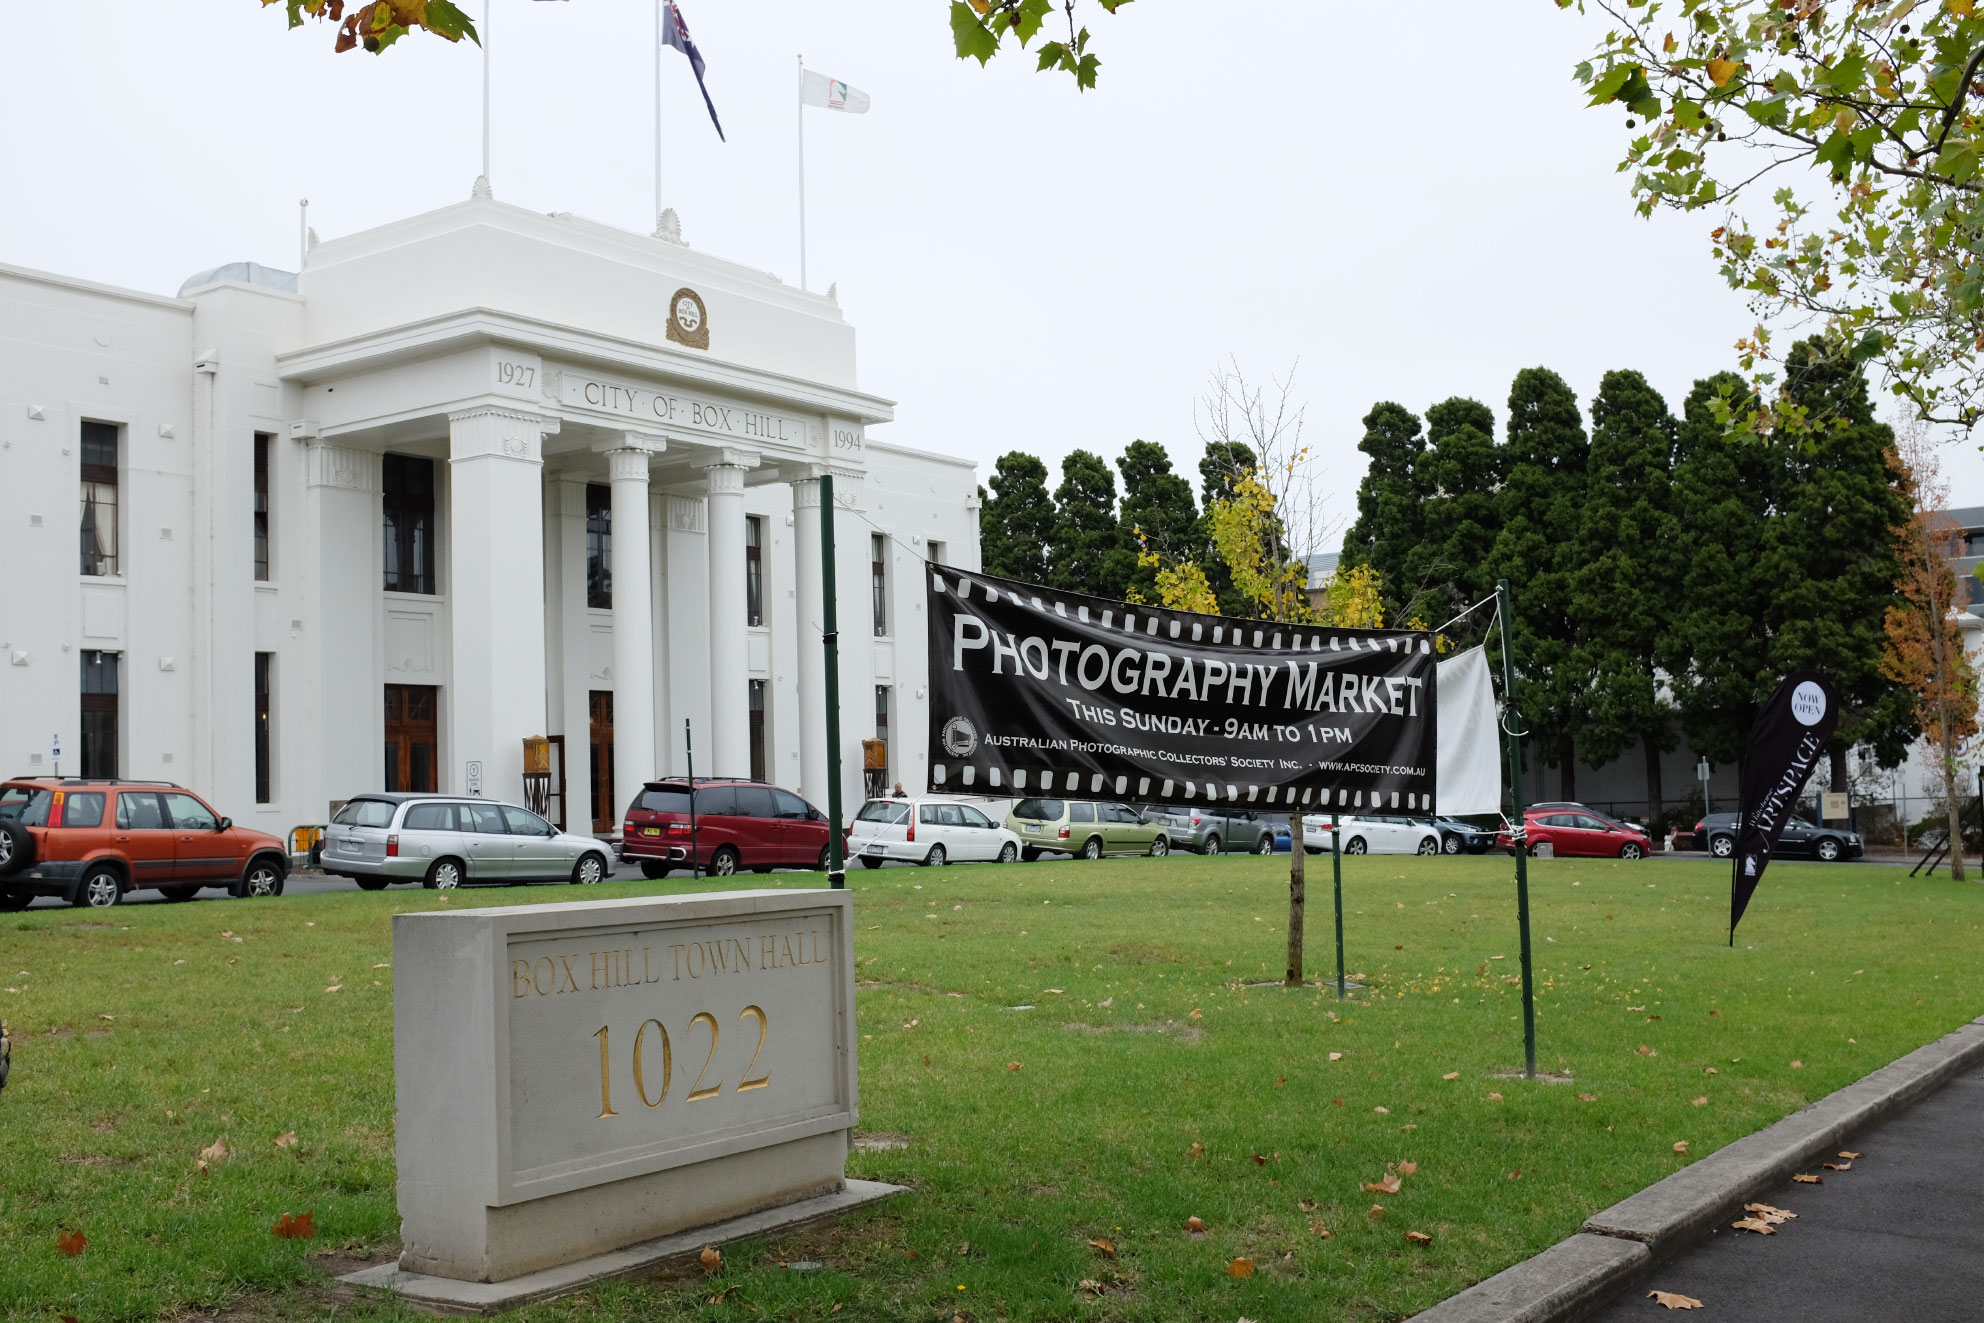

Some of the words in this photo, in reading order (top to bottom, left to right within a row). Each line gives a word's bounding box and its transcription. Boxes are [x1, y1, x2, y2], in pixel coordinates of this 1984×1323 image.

[496, 361, 535, 388] 1927
[584, 382, 638, 412] CITY
[653, 396, 677, 419] OF
[692, 402, 732, 431] BOX
[745, 412, 788, 441] HILL
[833, 430, 862, 451] 1994
[953, 613, 1279, 707] PHOTOGRAPHY
[1283, 660, 1423, 717] MARKET
[1066, 698, 1117, 726] THIS
[1119, 707, 1211, 737] SUNDAY
[1223, 718, 1269, 741] 9AM
[1273, 725, 1300, 743] TO
[1307, 724, 1353, 743] 1PM
[1794, 703, 1821, 714] OPEN
[1798, 692, 1819, 704] NOW
[984, 733, 1067, 750] AUSTRALIAN
[1070, 739, 1156, 760] PHOTOGRAPHIC
[1158, 750, 1228, 767] COLLECTORS'
[1230, 756, 1275, 769] SOCIETY
[1279, 758, 1302, 769] INC.
[1319, 760, 1426, 777] WWW.APCSOCIETY.COM.AU
[1757, 731, 1820, 853] ARTSPACE
[512, 955, 580, 999] BOX
[590, 947, 660, 990] HILL
[668, 937, 751, 981] TOWN
[759, 930, 827, 970] HALL
[592, 1004, 772, 1119] 1022
